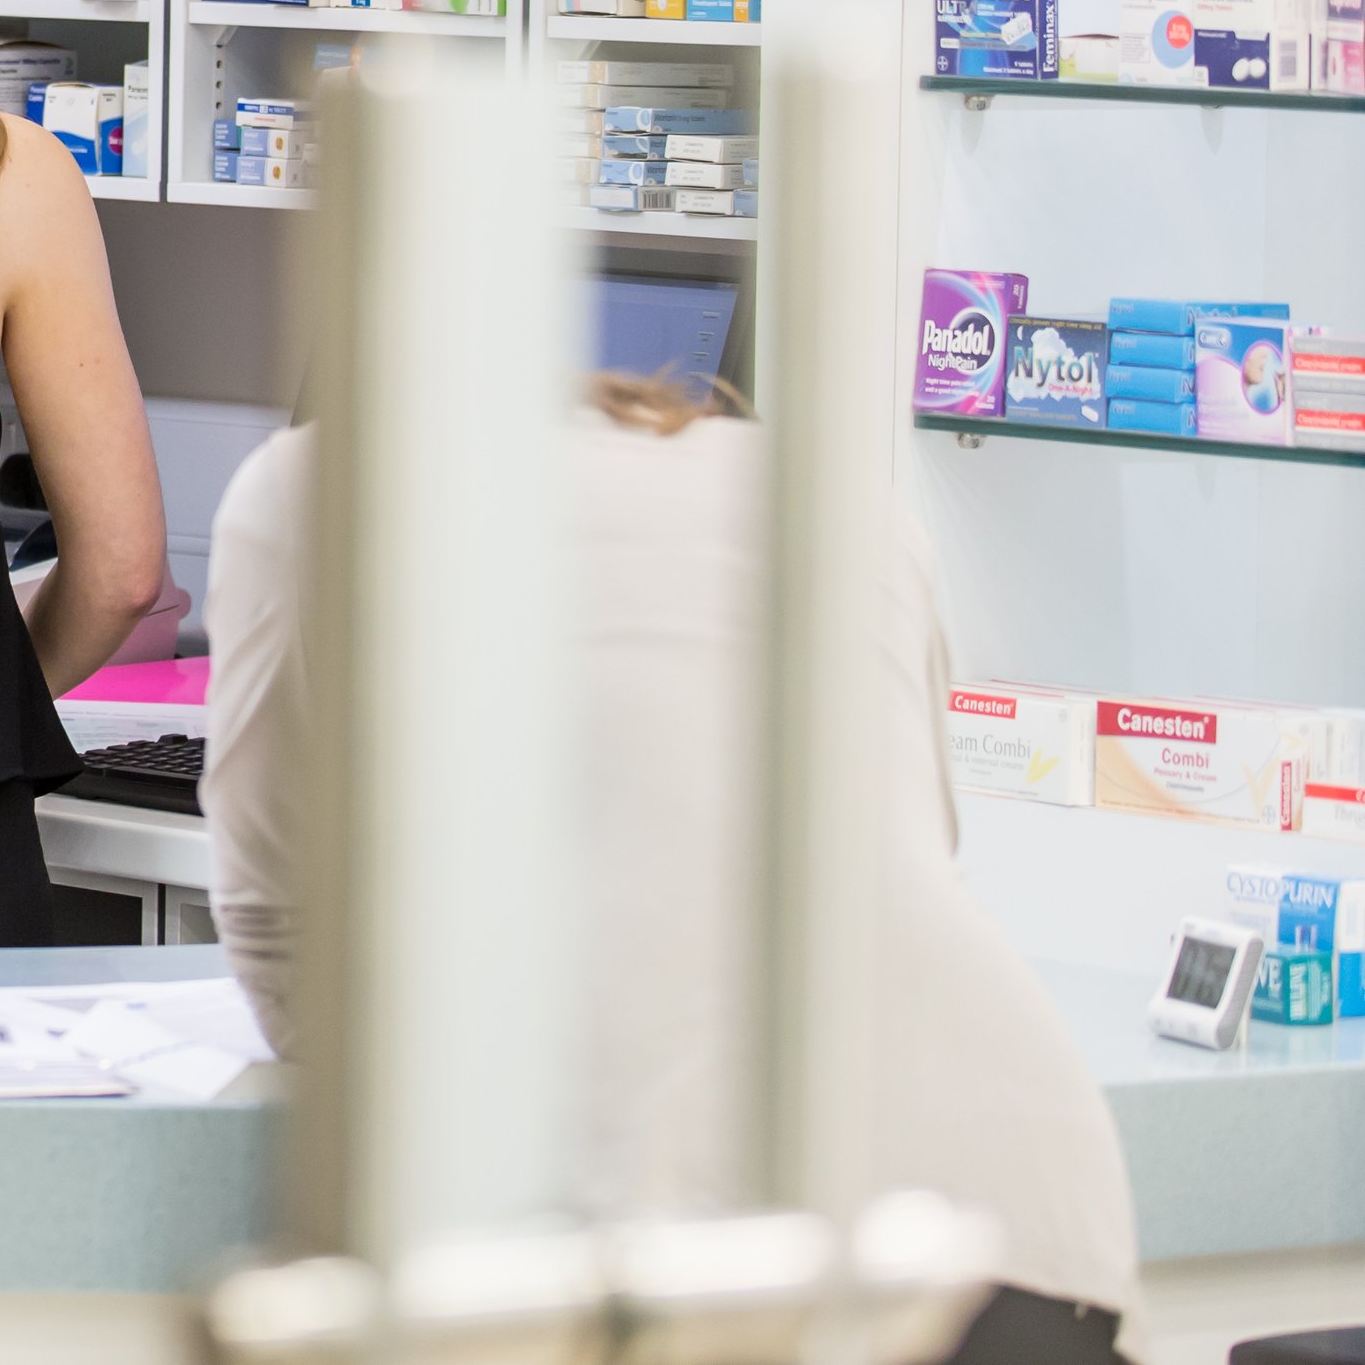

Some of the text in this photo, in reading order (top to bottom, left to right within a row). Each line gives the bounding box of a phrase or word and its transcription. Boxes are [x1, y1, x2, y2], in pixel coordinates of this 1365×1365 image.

[1043, 5, 1054, 72] Feminax
[922, 319, 991, 356] Panadol
[1013, 345, 1095, 388] Nytol
[954, 695, 1013, 715] Canesten
[1117, 707, 1207, 740] Canesten
[982, 734, 1031, 759] Combi
[1161, 747, 1210, 769] Combi
[1153, 767, 1183, 781] Pessary
[1192, 771, 1217, 782] Cream
[1282, 764, 1291, 825] Canesten
[1226, 872, 1336, 909] CYSTOPURIN
